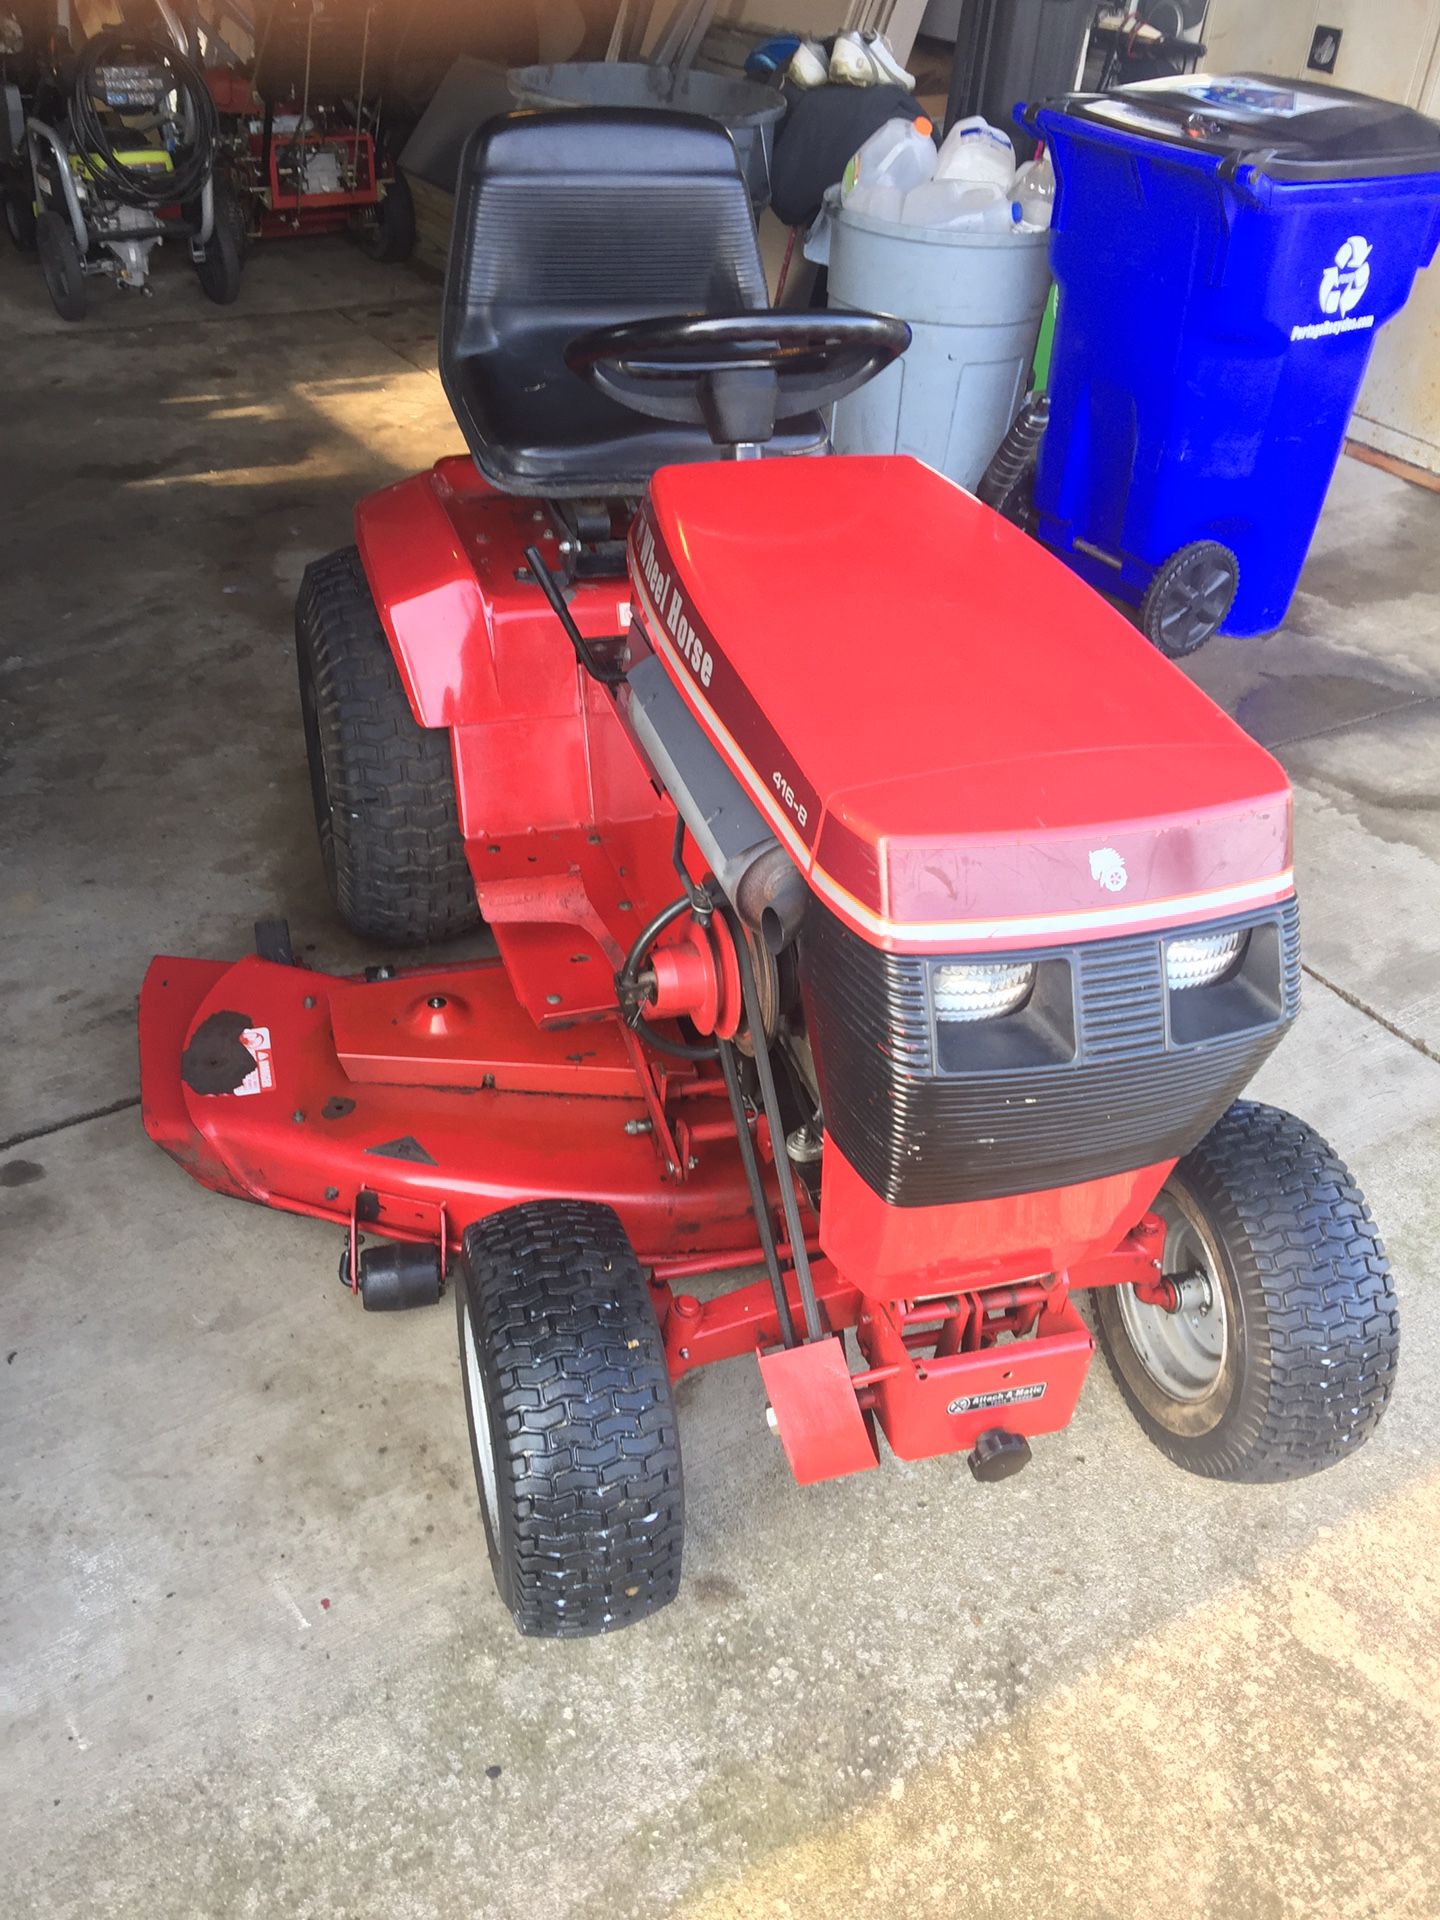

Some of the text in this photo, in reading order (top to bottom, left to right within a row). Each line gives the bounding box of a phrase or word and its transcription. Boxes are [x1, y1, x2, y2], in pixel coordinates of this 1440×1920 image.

[640, 523, 713, 687] Wheel Horse
[773, 772, 807, 827] 416-8
